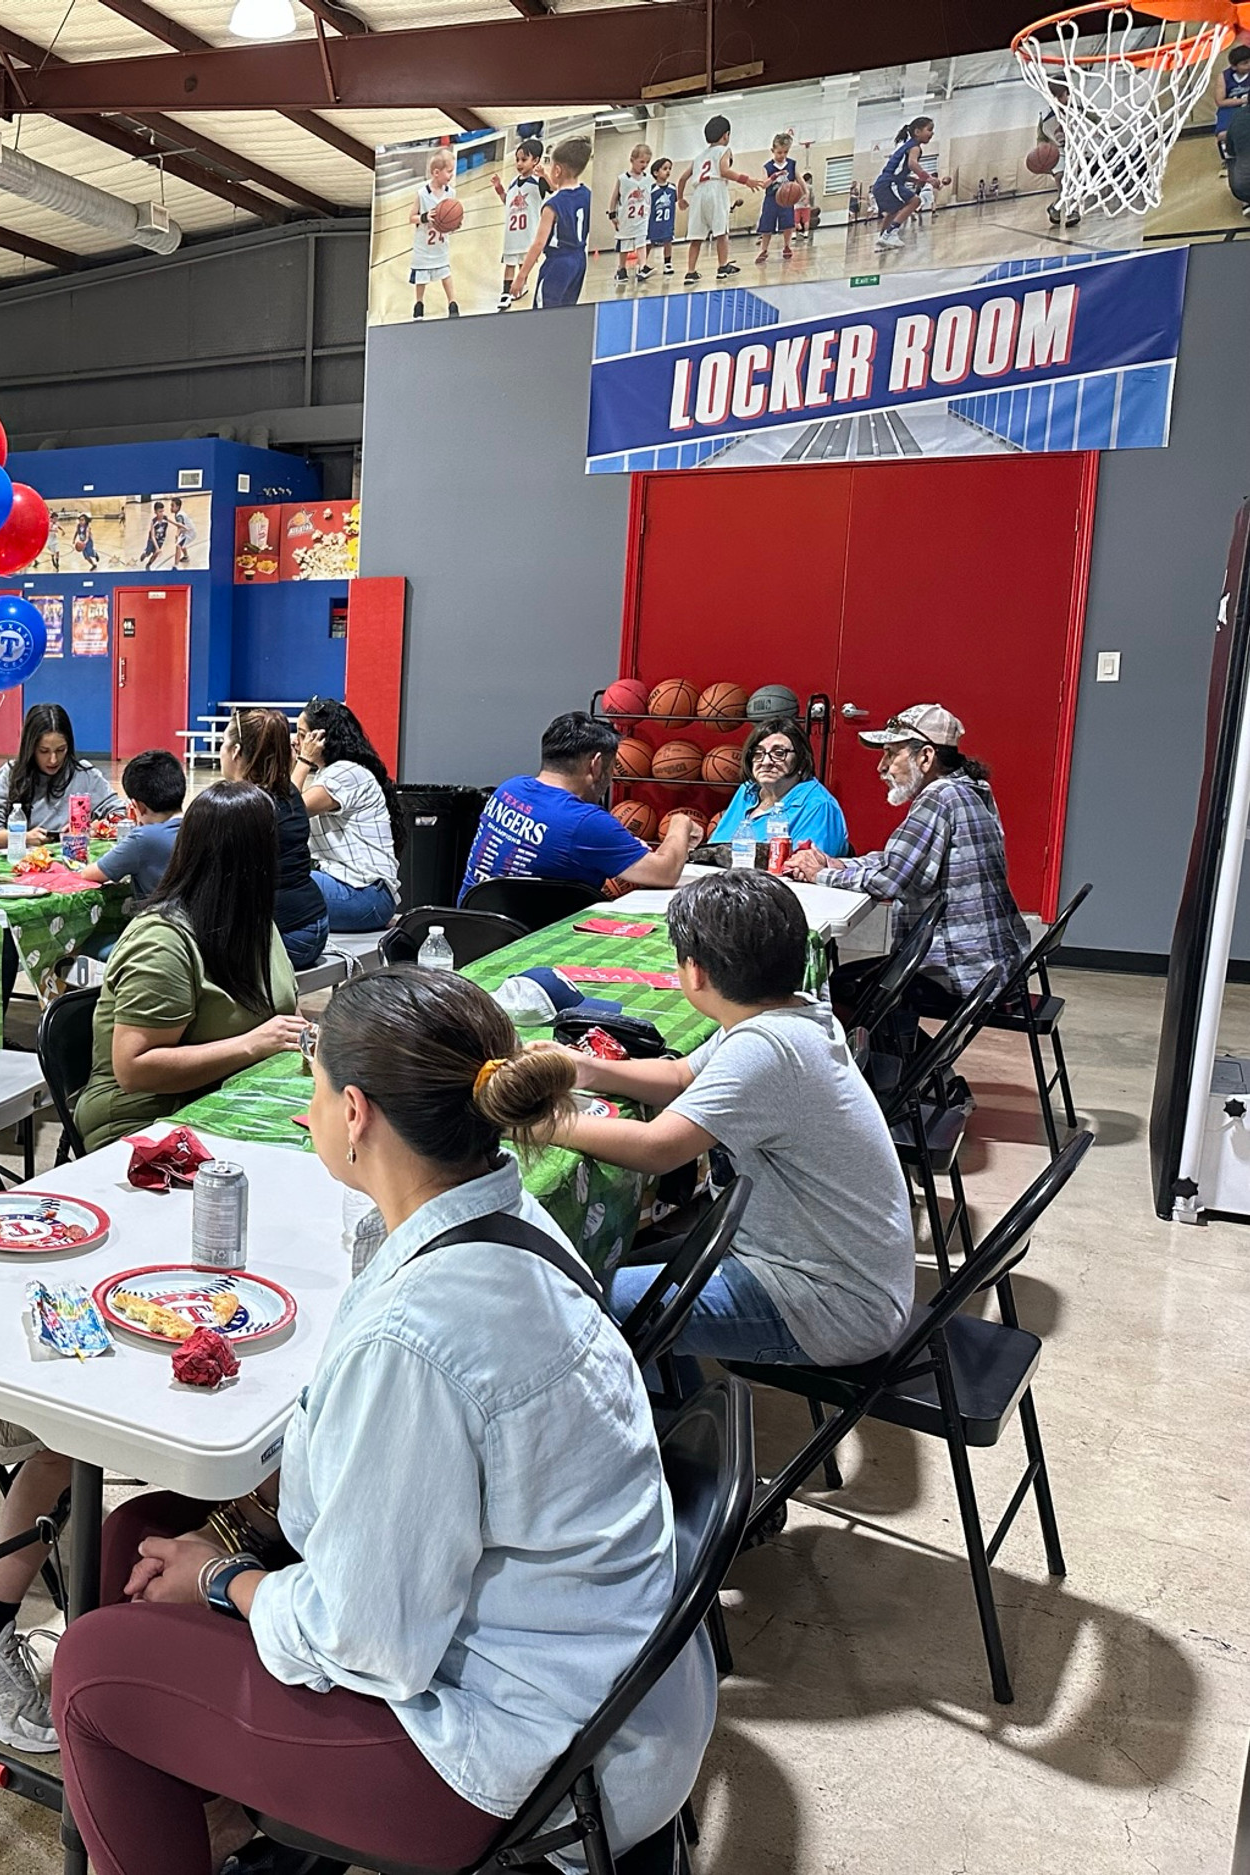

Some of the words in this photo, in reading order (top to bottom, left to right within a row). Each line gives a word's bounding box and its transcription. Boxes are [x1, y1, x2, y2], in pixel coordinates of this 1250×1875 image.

[700, 159, 712, 182] 2
[509, 213, 528, 232] 20
[627, 204, 645, 219] 24
[655, 208, 671, 222] 20
[575, 207, 585, 243] 1
[669, 325, 878, 431] LOCKER
[887, 284, 1081, 393] ROOM
[0, 636, 20, 659] T
[501, 790, 534, 815] TEXAS
[483, 795, 549, 845] ANGERS
